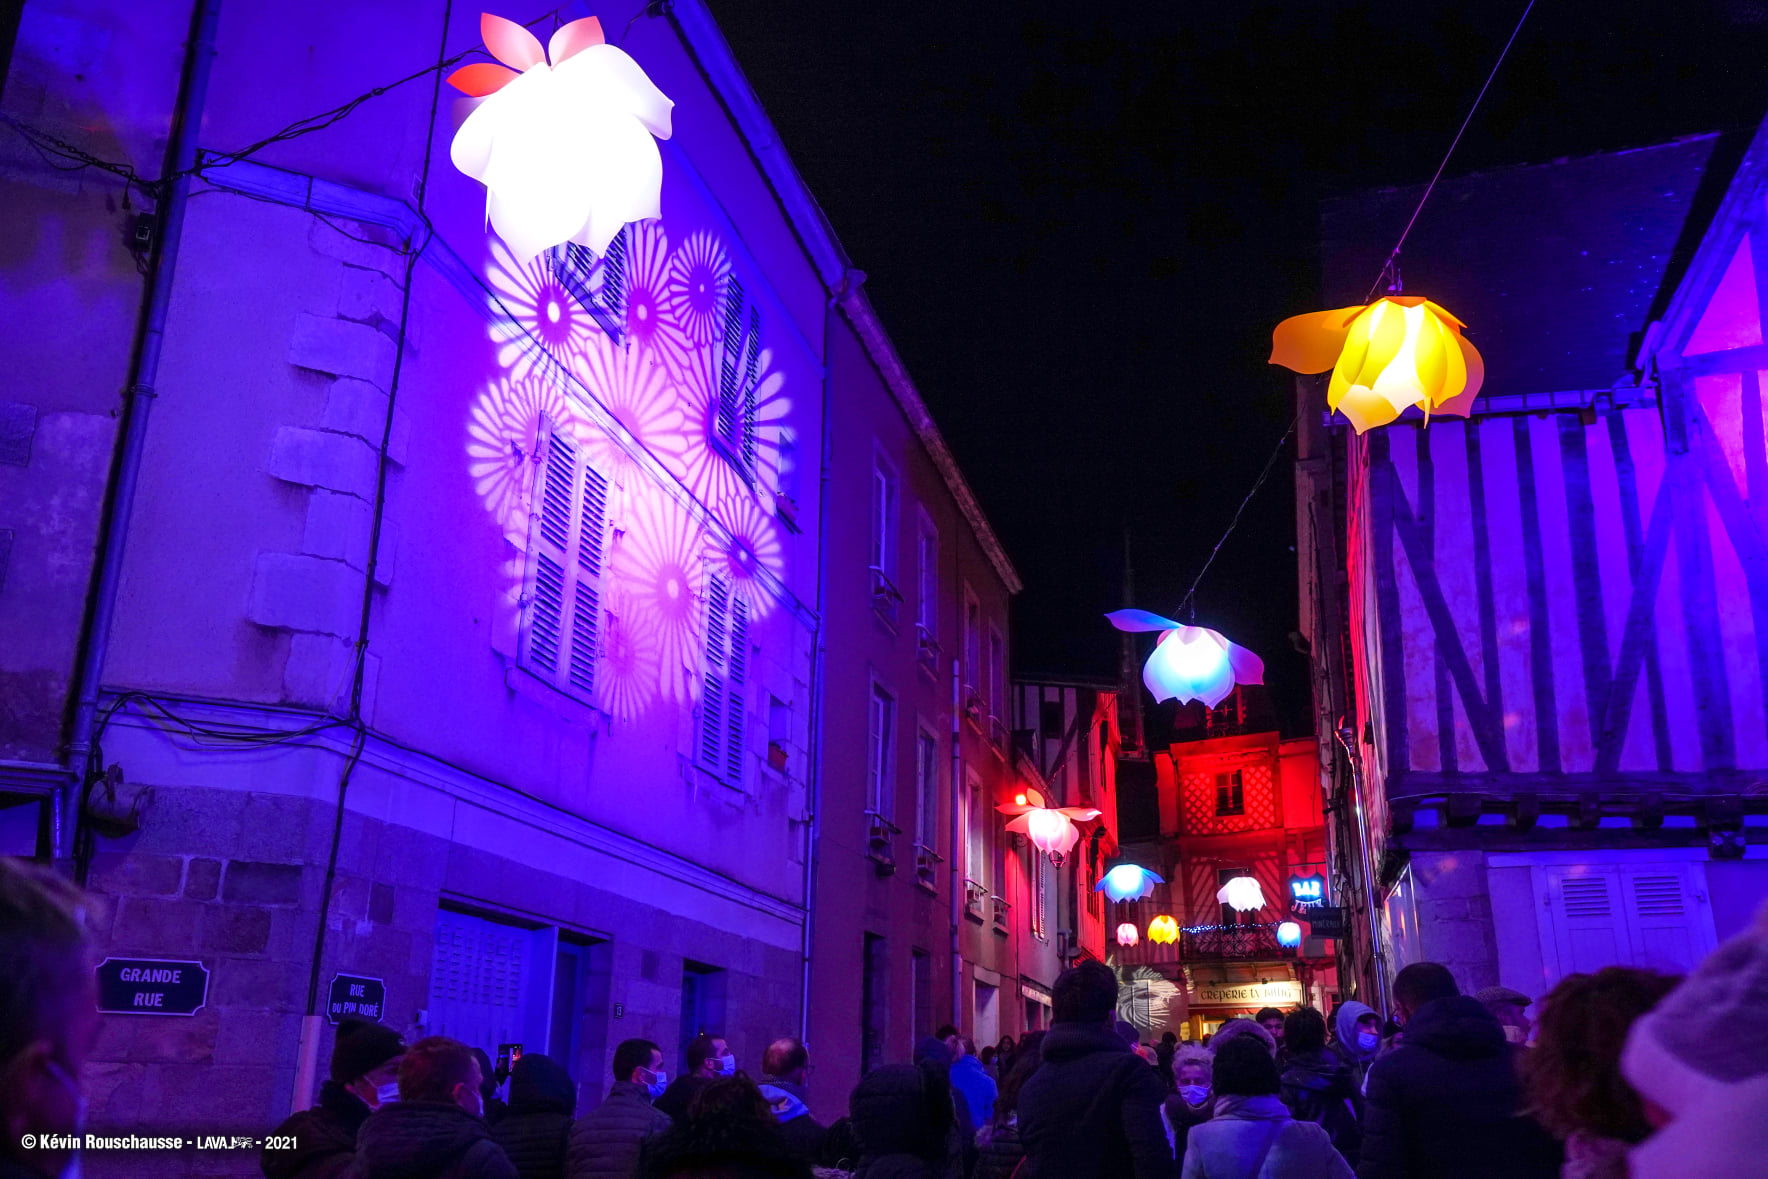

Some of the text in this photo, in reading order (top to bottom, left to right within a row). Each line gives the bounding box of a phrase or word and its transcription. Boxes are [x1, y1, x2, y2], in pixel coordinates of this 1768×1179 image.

[1292, 881, 1321, 897] BAR
[120, 967, 182, 984] GRANDE
[349, 983, 365, 998] RUE
[1200, 988, 1248, 1001] CREPERIE
[133, 992, 164, 1007] RUE
[332, 1001, 379, 1018] DU PIN DORÉ
